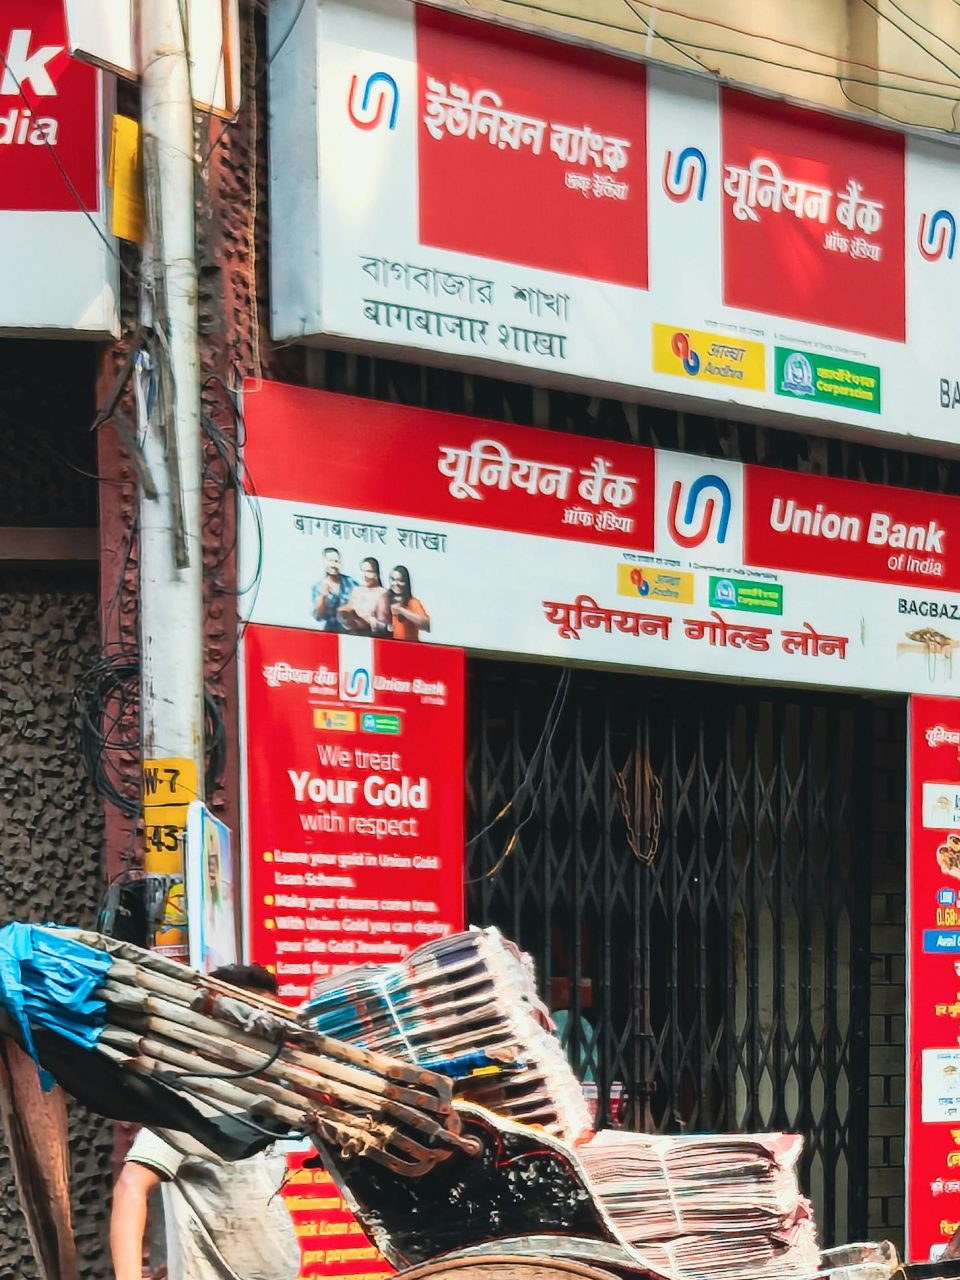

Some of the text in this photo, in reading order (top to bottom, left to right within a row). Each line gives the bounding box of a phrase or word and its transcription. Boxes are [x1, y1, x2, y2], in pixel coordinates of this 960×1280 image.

[424, 75, 631, 172] ইউনিয়ন ব্যাংক
[724, 158, 884, 234] यूनियन बैंक
[359, 256, 570, 322] বাগবাজার শাখা
[363, 299, 567, 359] बागबाजार शाखा
[704, 362, 744, 380] Andhra
[438, 439, 638, 508] यूनियन बैंक
[293, 514, 448, 553] बागबाजार शाखा
[562, 505, 593, 527] ऑफ
[769, 498, 945, 554] Union Bank
[888, 554, 942, 576] of India
[541, 594, 849, 660] यूनियन गोल्ड लोन
[316, 744, 401, 771] We treat
[288, 770, 429, 809] Your Gold
[300, 809, 418, 840] with respect
[379, 853, 411, 868] Union
[306, 916, 340, 931] Union
[319, 1221, 348, 1236] Loan
[303, 1247, 378, 1266] pre payment
